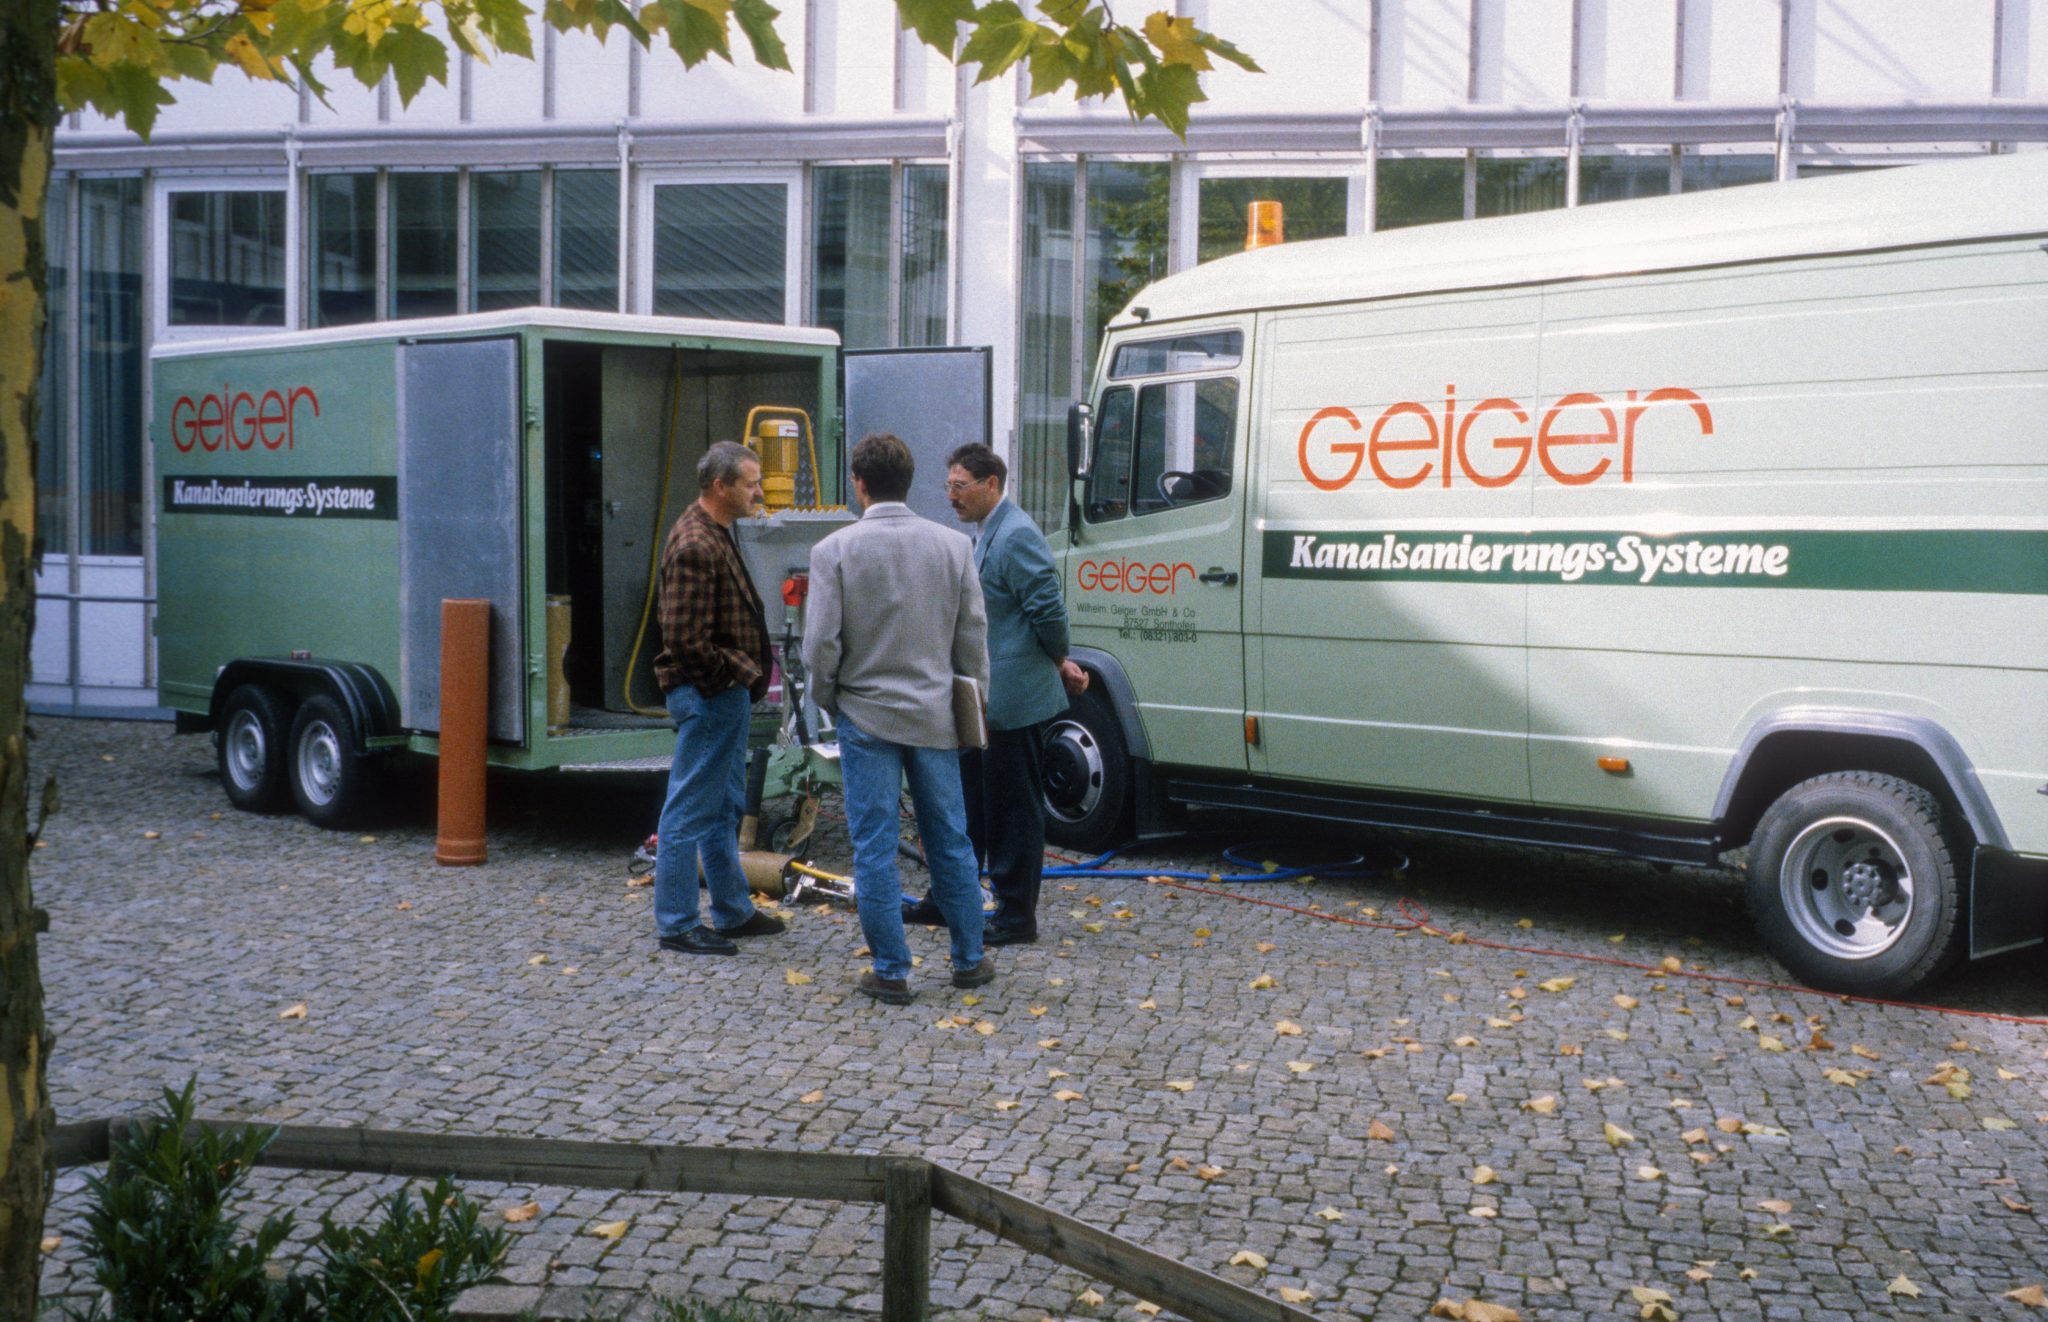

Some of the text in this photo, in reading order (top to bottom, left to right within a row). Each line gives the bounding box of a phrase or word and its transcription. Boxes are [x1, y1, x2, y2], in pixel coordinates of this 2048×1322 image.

[173, 479, 375, 515] Kanalsanierungs-Systeme
[1290, 534, 1789, 583] Kanalsanierungs-Systeme
[1076, 602, 1196, 618] Wilhelm Geiger GmbH & Co
[1153, 618, 1196, 632] Sonthofen
